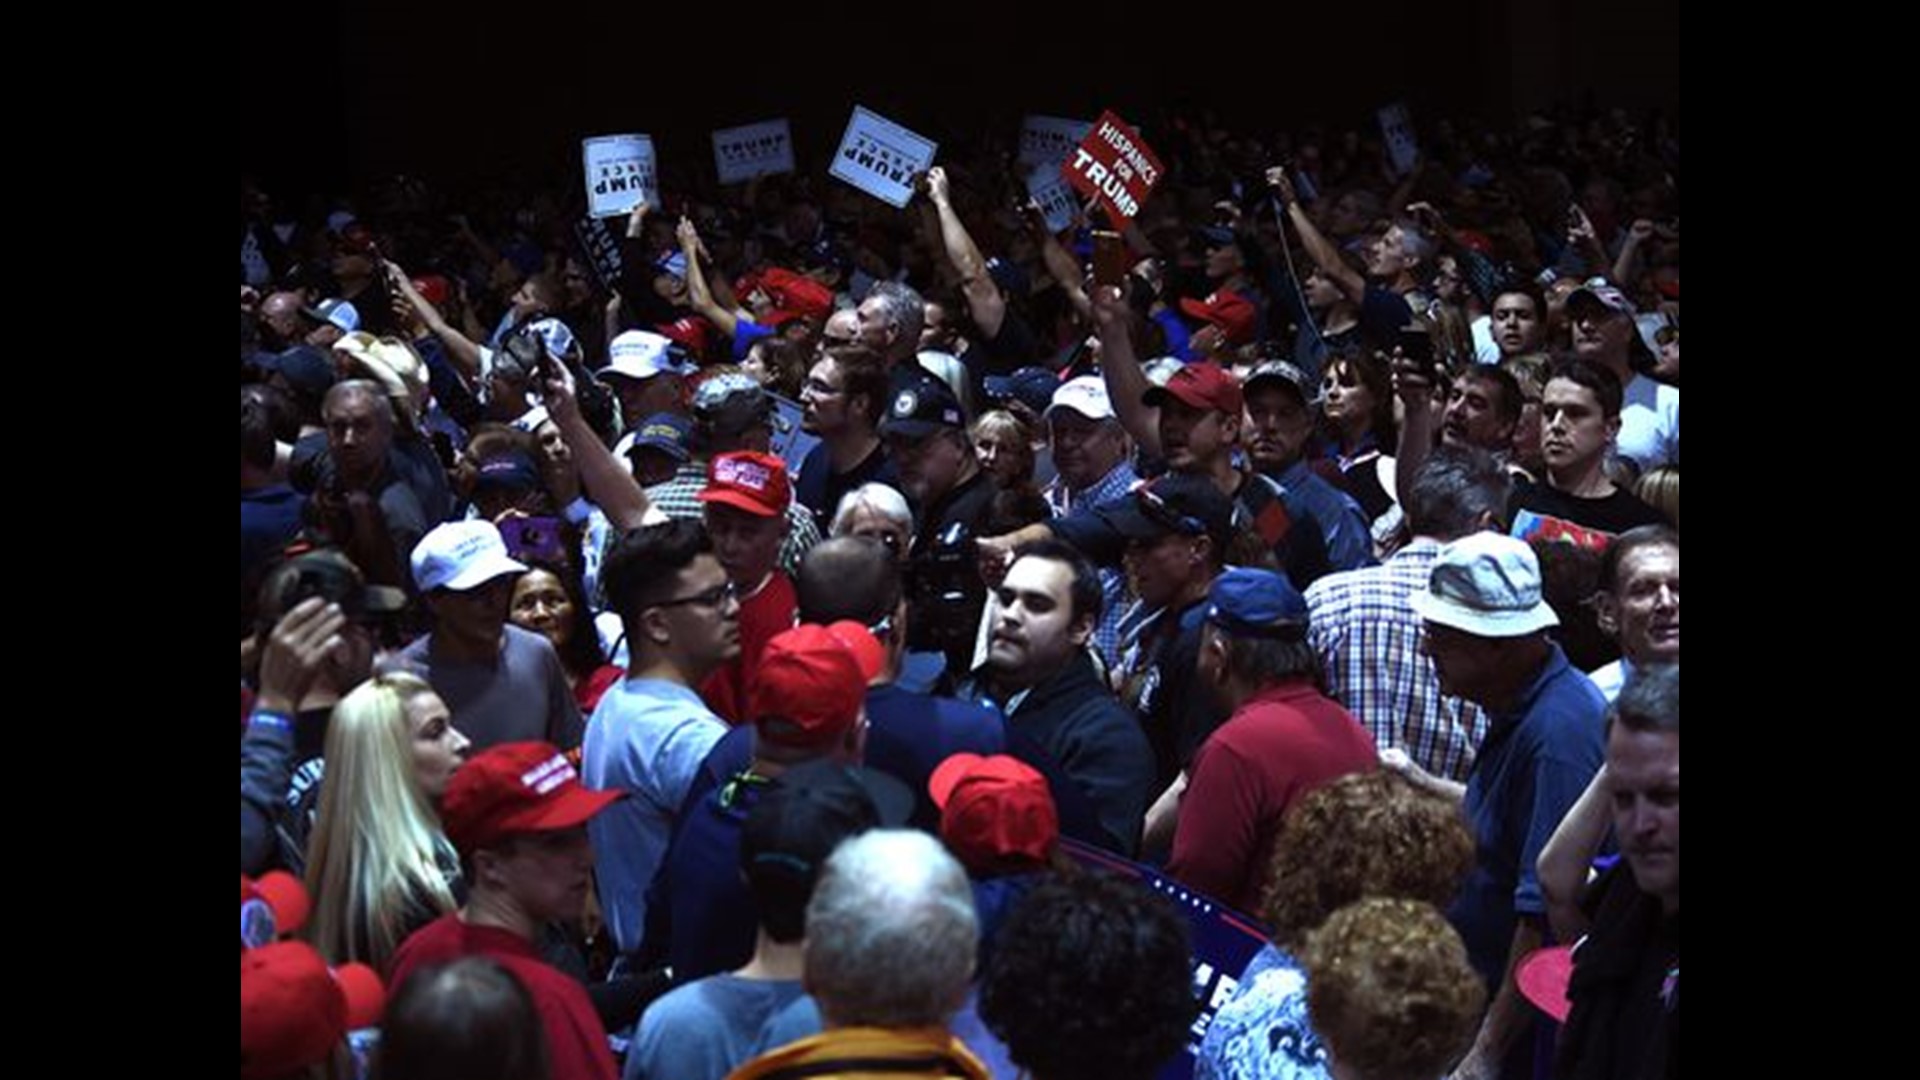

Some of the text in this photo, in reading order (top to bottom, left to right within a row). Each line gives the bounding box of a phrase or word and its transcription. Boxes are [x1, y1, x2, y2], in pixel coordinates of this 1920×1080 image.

[844, 148, 914, 189] TRUMP
[1098, 121, 1157, 186] HISPANICS
[1112, 158, 1134, 182] FOR
[1072, 148, 1139, 218] TRUMP
